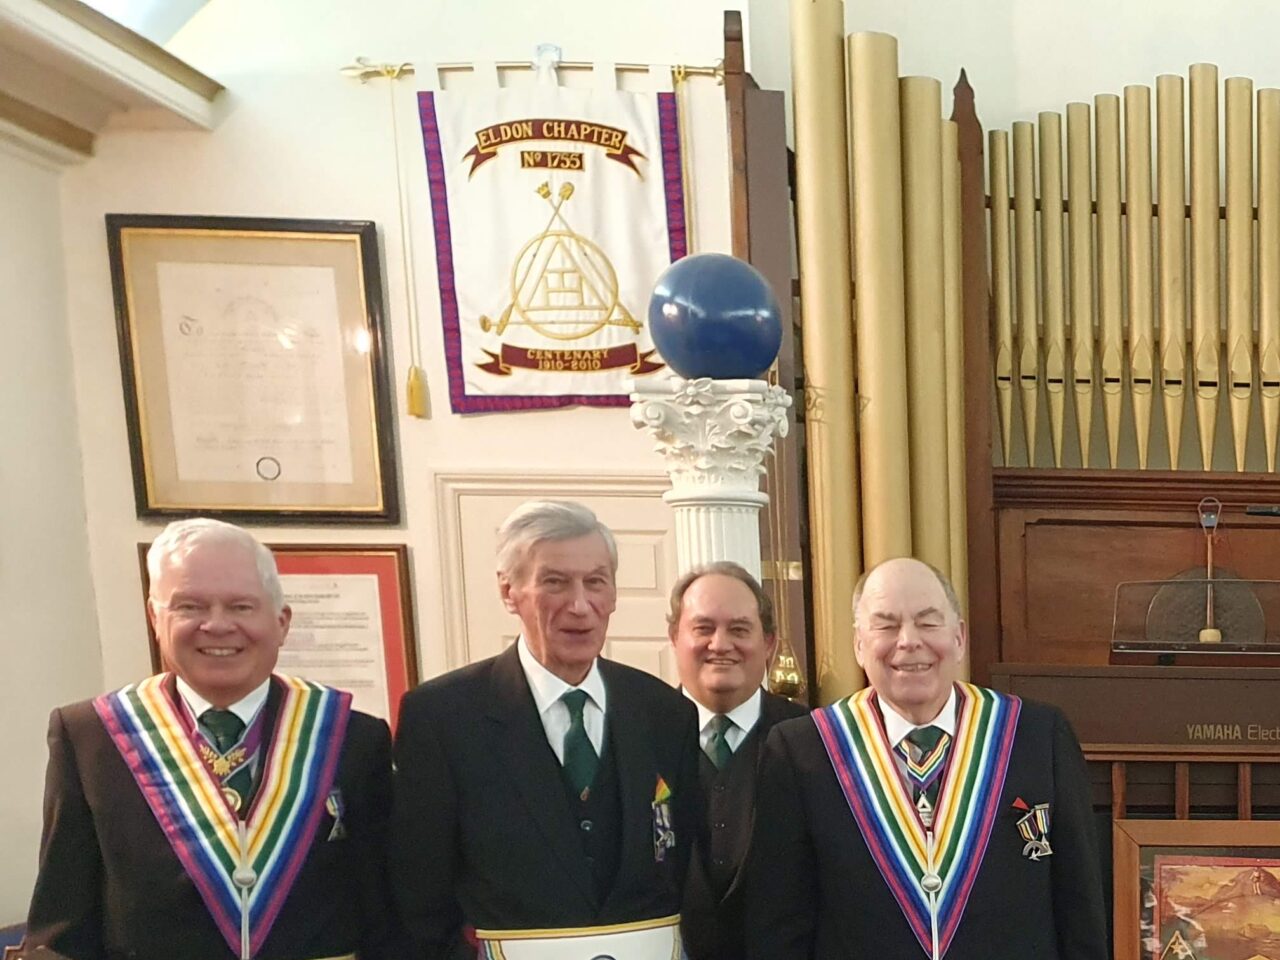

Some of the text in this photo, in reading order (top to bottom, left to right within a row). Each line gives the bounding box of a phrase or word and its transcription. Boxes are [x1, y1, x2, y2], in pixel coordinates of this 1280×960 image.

[478, 121, 623, 148] ELDON CHAPTER
[547, 154, 581, 168] 1755
[527, 349, 609, 360] CENTENARY
[538, 360, 600, 370] 1910-2010
[1186, 724, 1242, 740] YAMAHA
